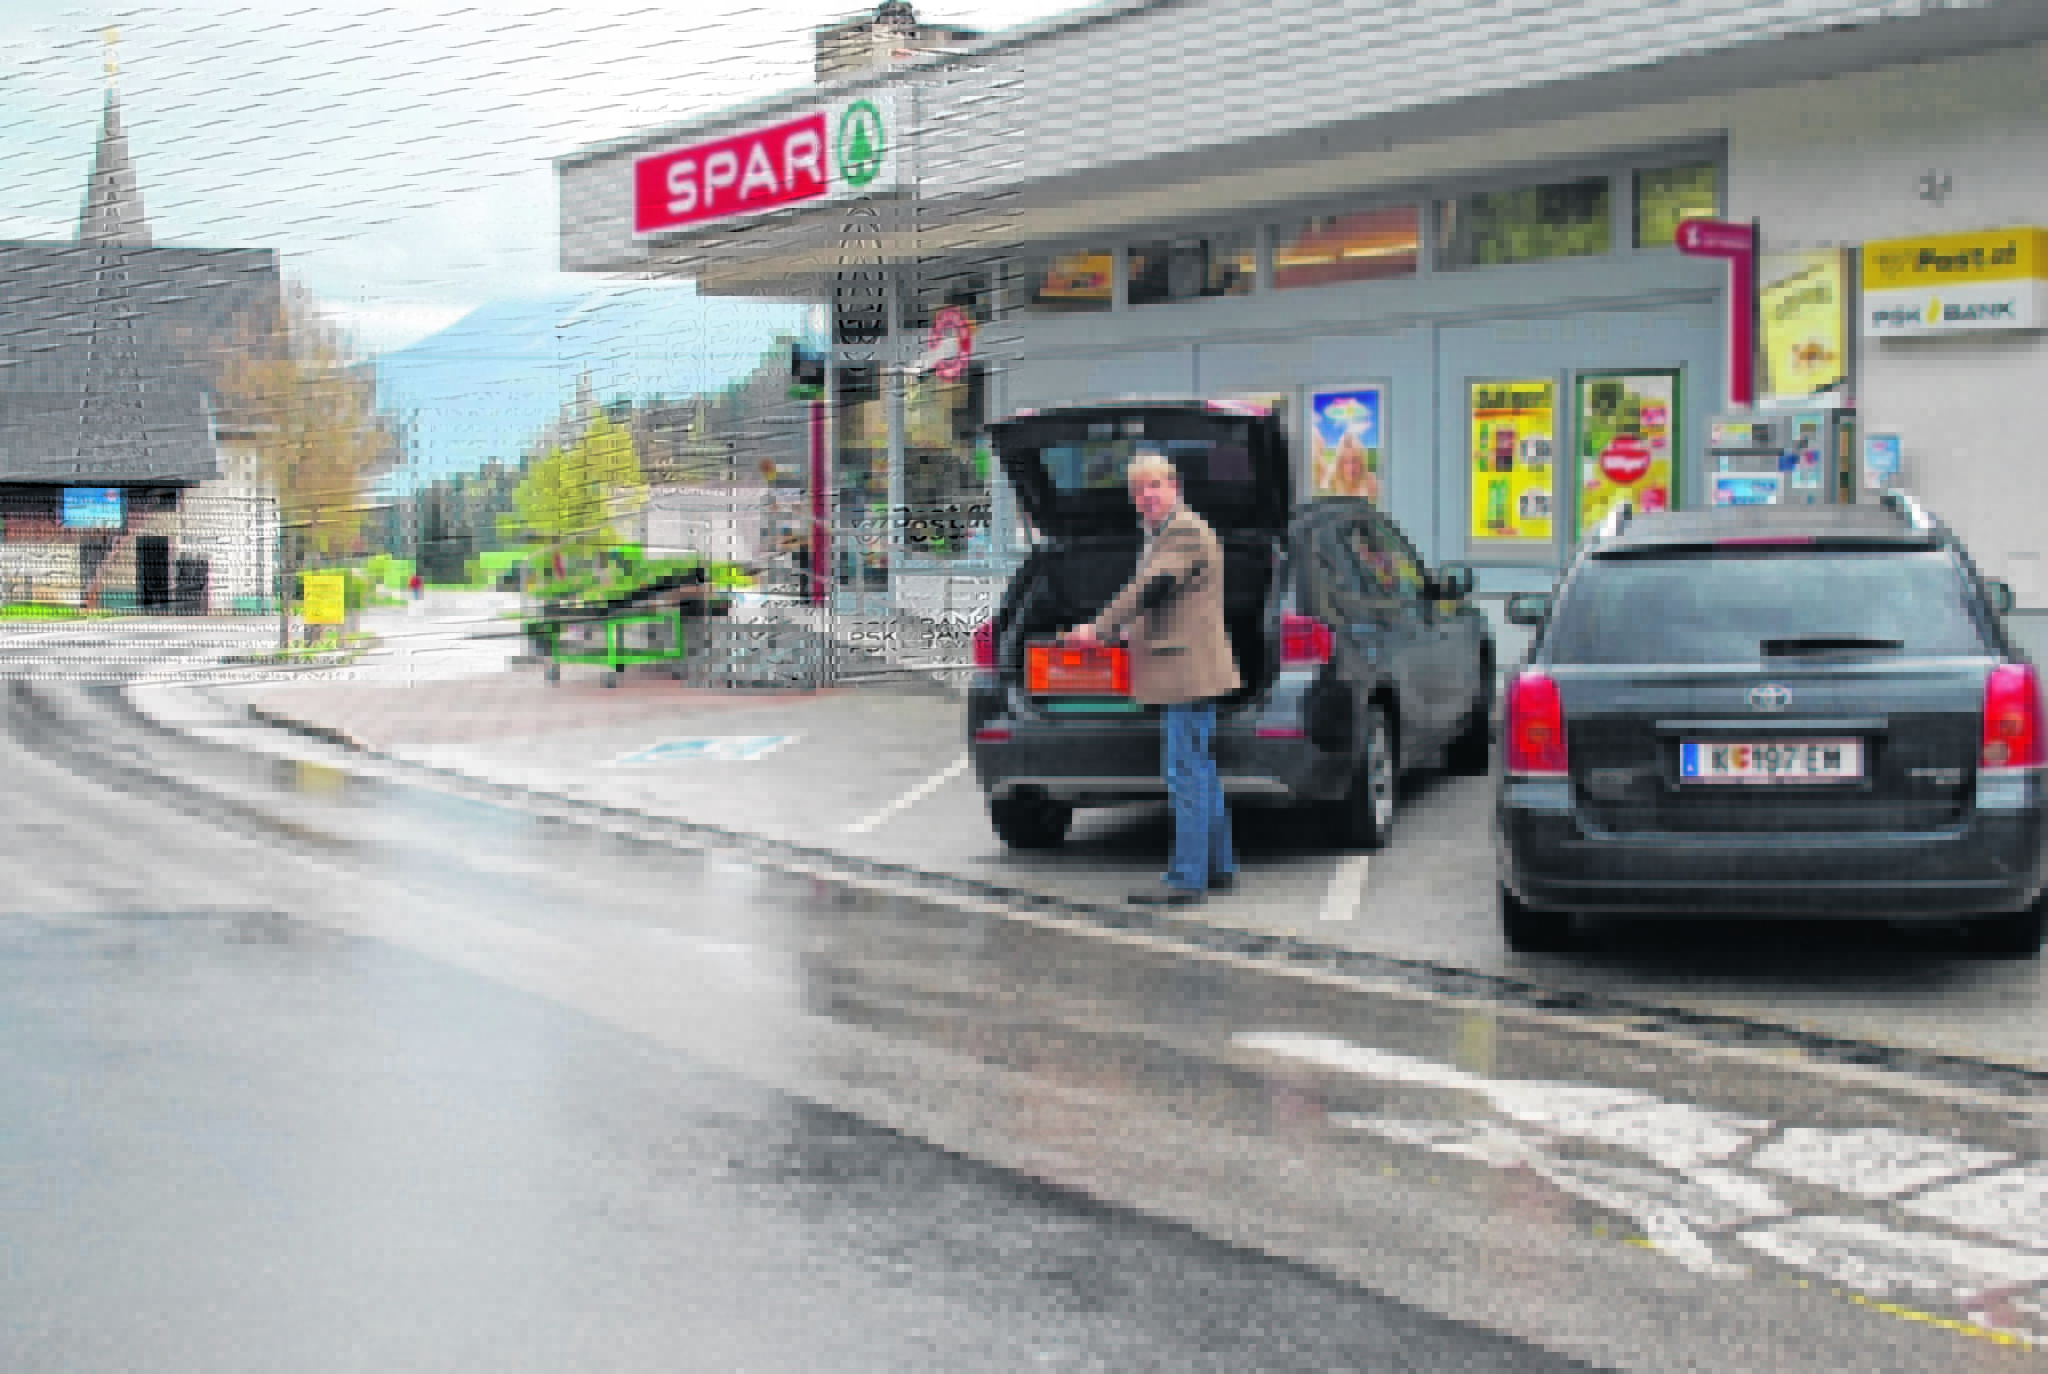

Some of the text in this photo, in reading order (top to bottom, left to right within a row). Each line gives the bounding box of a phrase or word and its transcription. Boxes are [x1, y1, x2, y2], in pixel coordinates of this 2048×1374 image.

[667, 130, 821, 214] SPAR
[1875, 300, 2015, 326] PSK BANK
